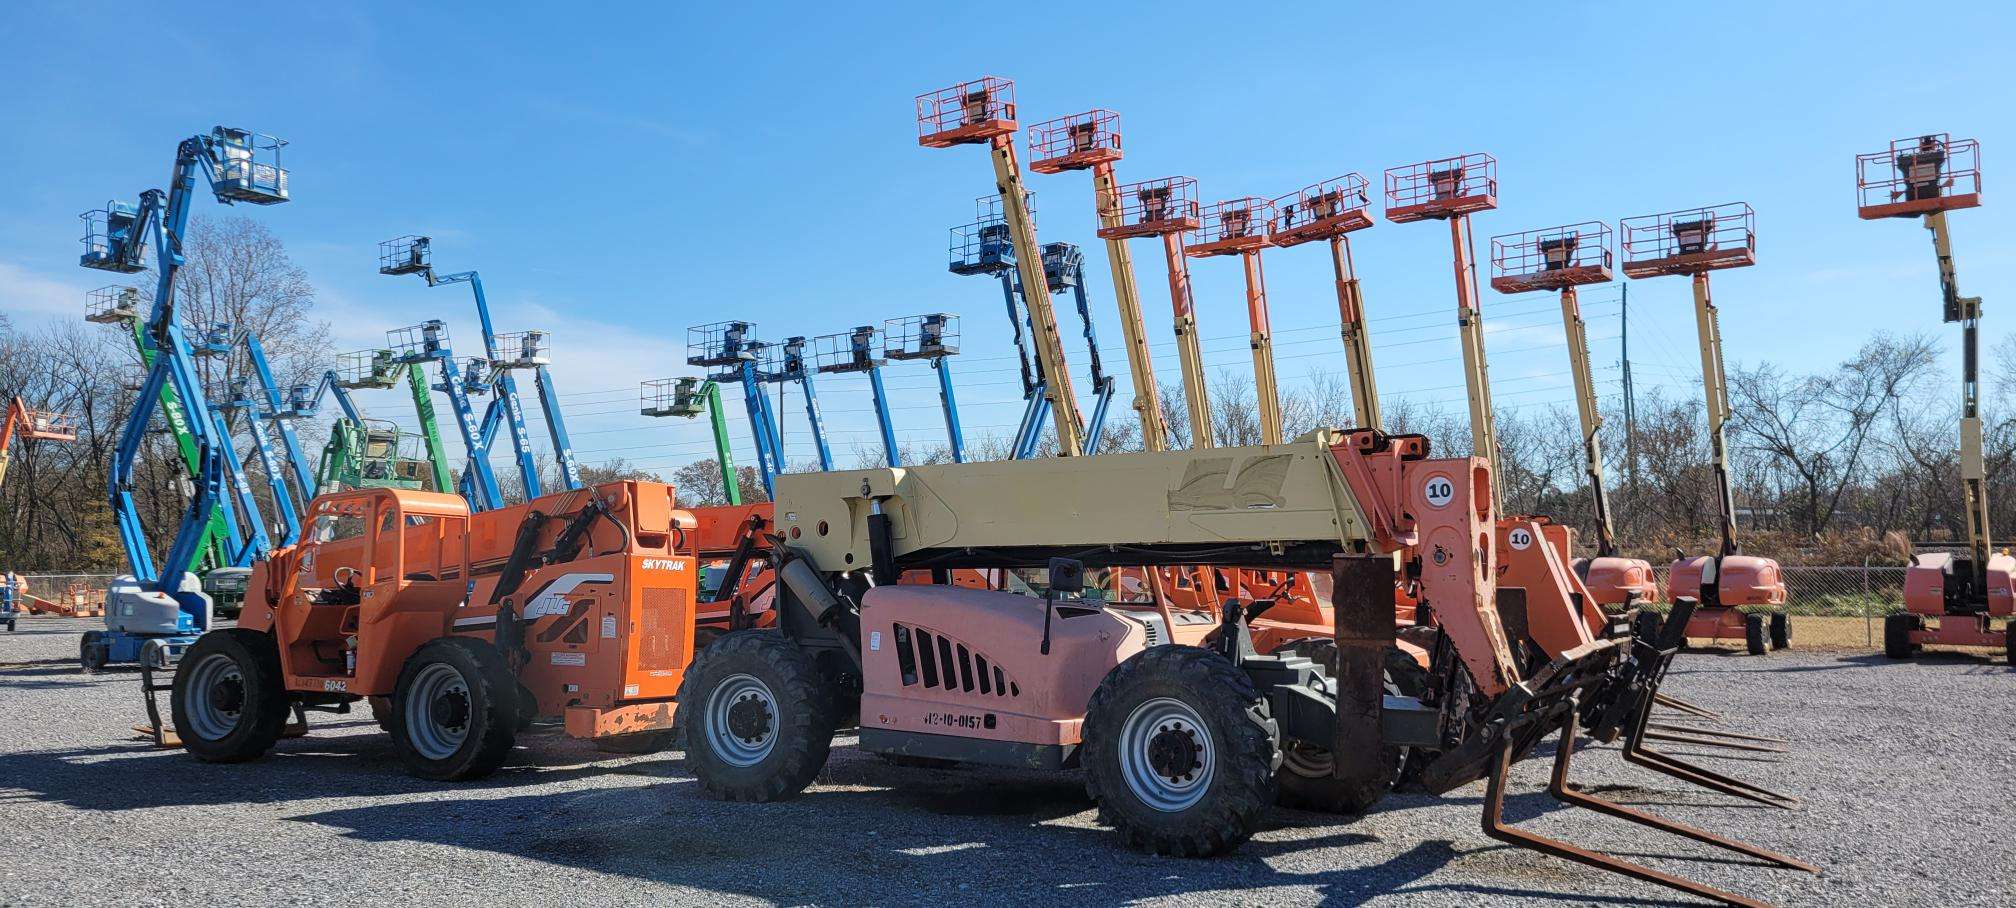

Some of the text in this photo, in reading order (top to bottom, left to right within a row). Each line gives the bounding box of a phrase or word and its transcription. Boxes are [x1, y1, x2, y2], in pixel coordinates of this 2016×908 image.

[517, 427, 531, 453] S-65
[563, 448, 580, 482] S-60X
[1428, 483, 1451, 498] 10
[1511, 533, 1530, 545] 10
[641, 558, 685, 571] SKYTRAK
[536, 597, 570, 615] JLG
[324, 680, 347, 691] 6042
